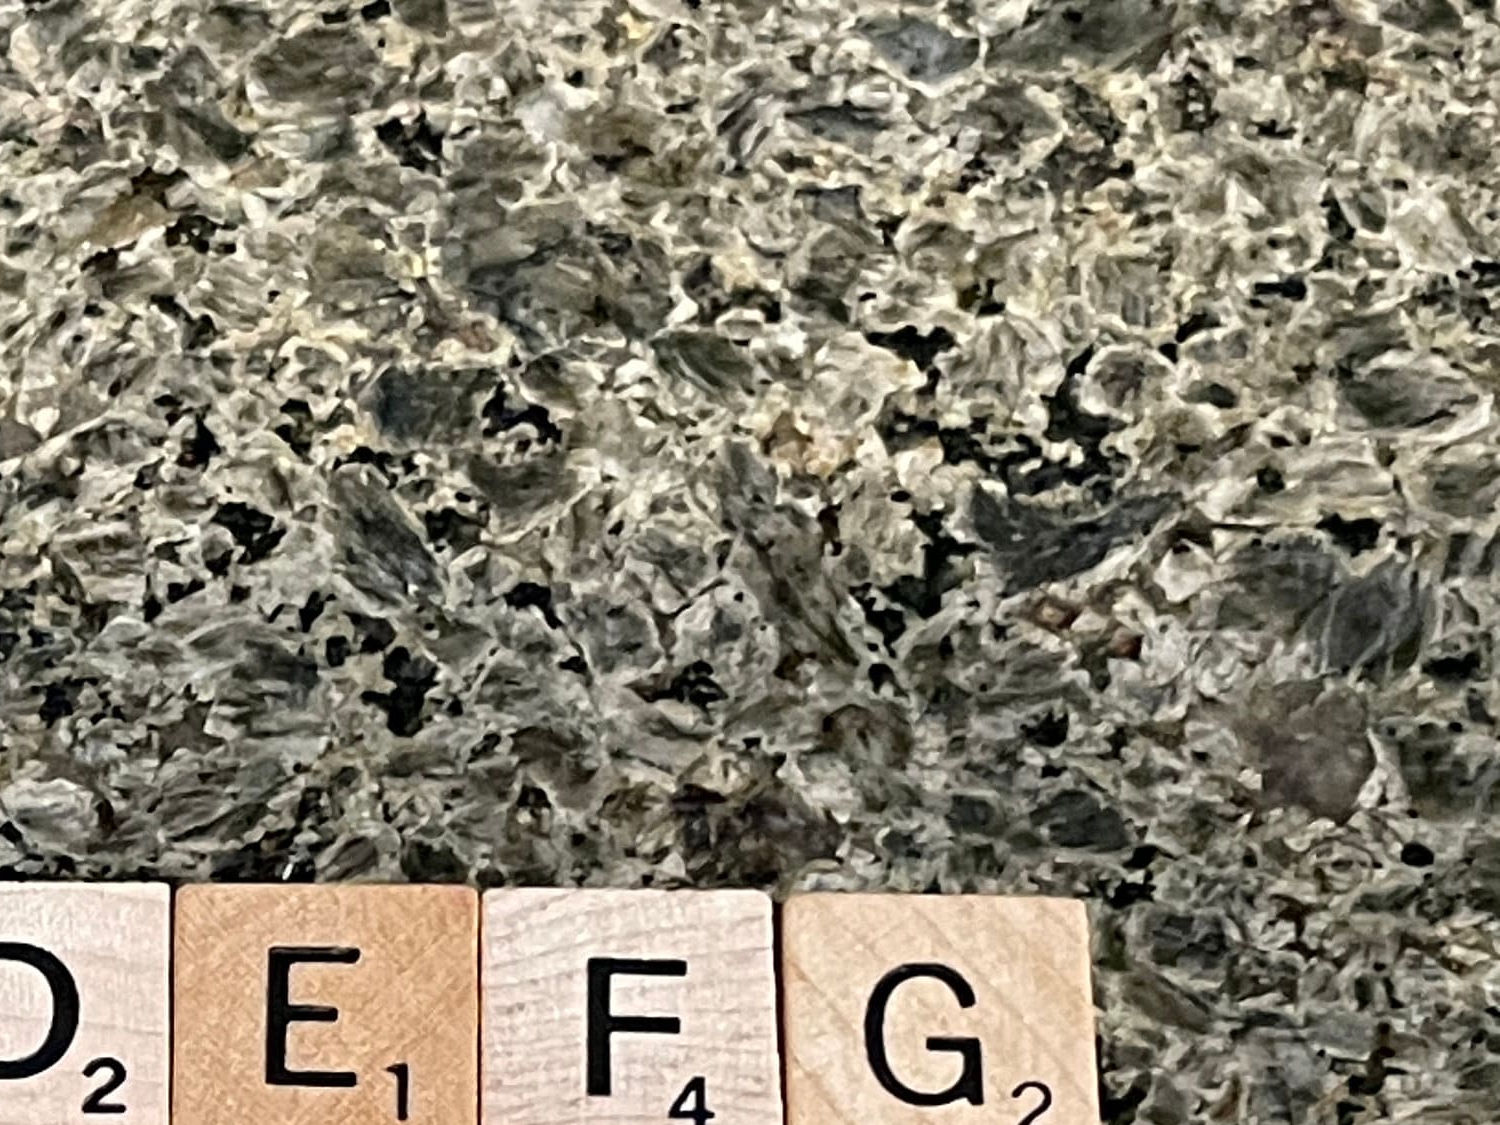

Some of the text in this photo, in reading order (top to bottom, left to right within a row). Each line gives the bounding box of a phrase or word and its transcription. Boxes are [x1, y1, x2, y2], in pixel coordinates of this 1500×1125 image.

[81, 1057, 127, 1114] 2
[265, 946, 409, 1122] E 1
[586, 957, 688, 1097] F
[864, 963, 985, 1107] G
